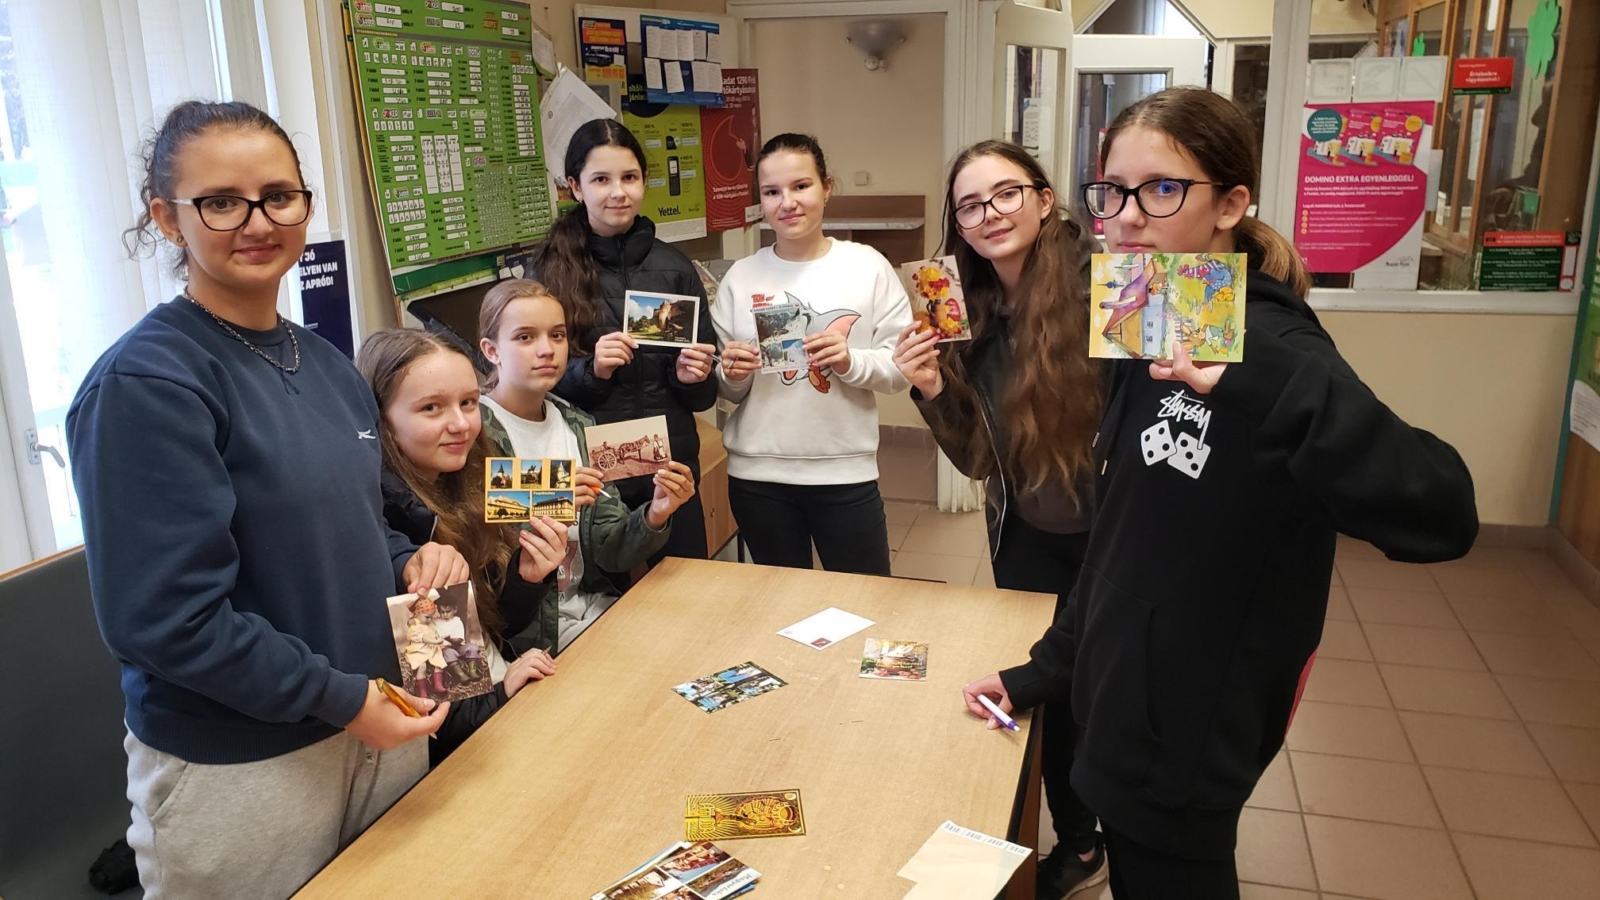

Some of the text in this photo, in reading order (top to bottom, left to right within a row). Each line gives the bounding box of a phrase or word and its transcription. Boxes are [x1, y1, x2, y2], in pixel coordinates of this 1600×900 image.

[1304, 174, 1414, 183] DOMINO EXTRA EGYENLEGGEL!
[305, 248, 316, 262] JÓ
[299, 261, 338, 277] ELYEN VAN
[305, 275, 334, 290] APRÓD!
